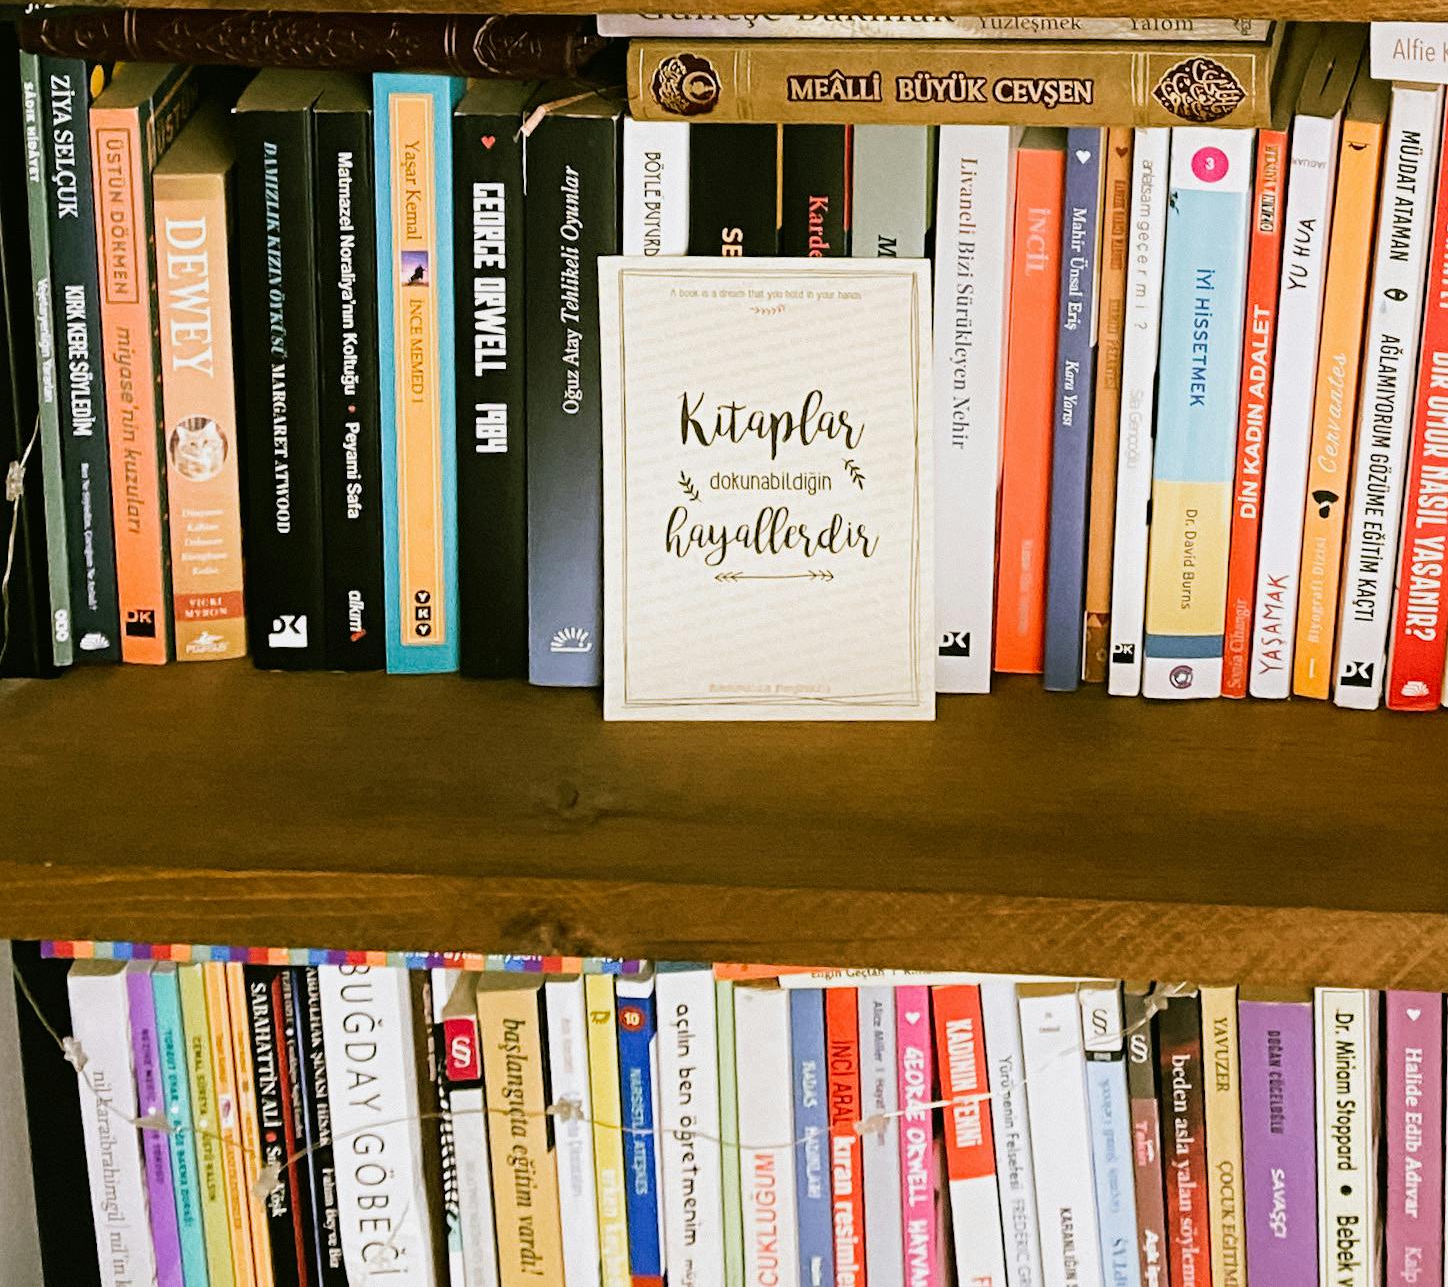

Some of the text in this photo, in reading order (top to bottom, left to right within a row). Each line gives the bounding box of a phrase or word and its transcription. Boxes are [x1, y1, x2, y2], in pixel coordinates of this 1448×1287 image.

[1392, 39, 1435, 63] Alfie
[51, 75, 78, 219] ZİYA SELÇUK
[106, 140, 128, 295] ÜSTÜN DÖKMEN
[164, 217, 214, 378] DEWEY
[560, 166, 584, 414] Oğuz Atay Tehlikeli Oyunlar
[950, 158, 978, 450] Livaneli Bizi Sürükleyen Nehir
[1287, 219, 1316, 290] YU HUA
[1240, 304, 1271, 519] DİN KADIN ADALET
[1354, 131, 1421, 622] MÜJDAT ATAMAN AĞLAMIYORUM GÖZÜME EĞİTİM KAÇTI
[666, 506, 879, 566] hayallerdir
[710, 471, 831, 495] dokunabildiğin
[1181, 509, 1197, 610] Dr. David Burns
[1259, 574, 1289, 674] YAŞAMAK
[1405, 536, 1445, 642] YAŞANIR?
[1215, 1018, 1230, 1092] YAVUZER
[1171, 1055, 1193, 1211] beden asla yalan
[1335, 1008, 1358, 1271] Dr. Miriam Stoppard Bebek
